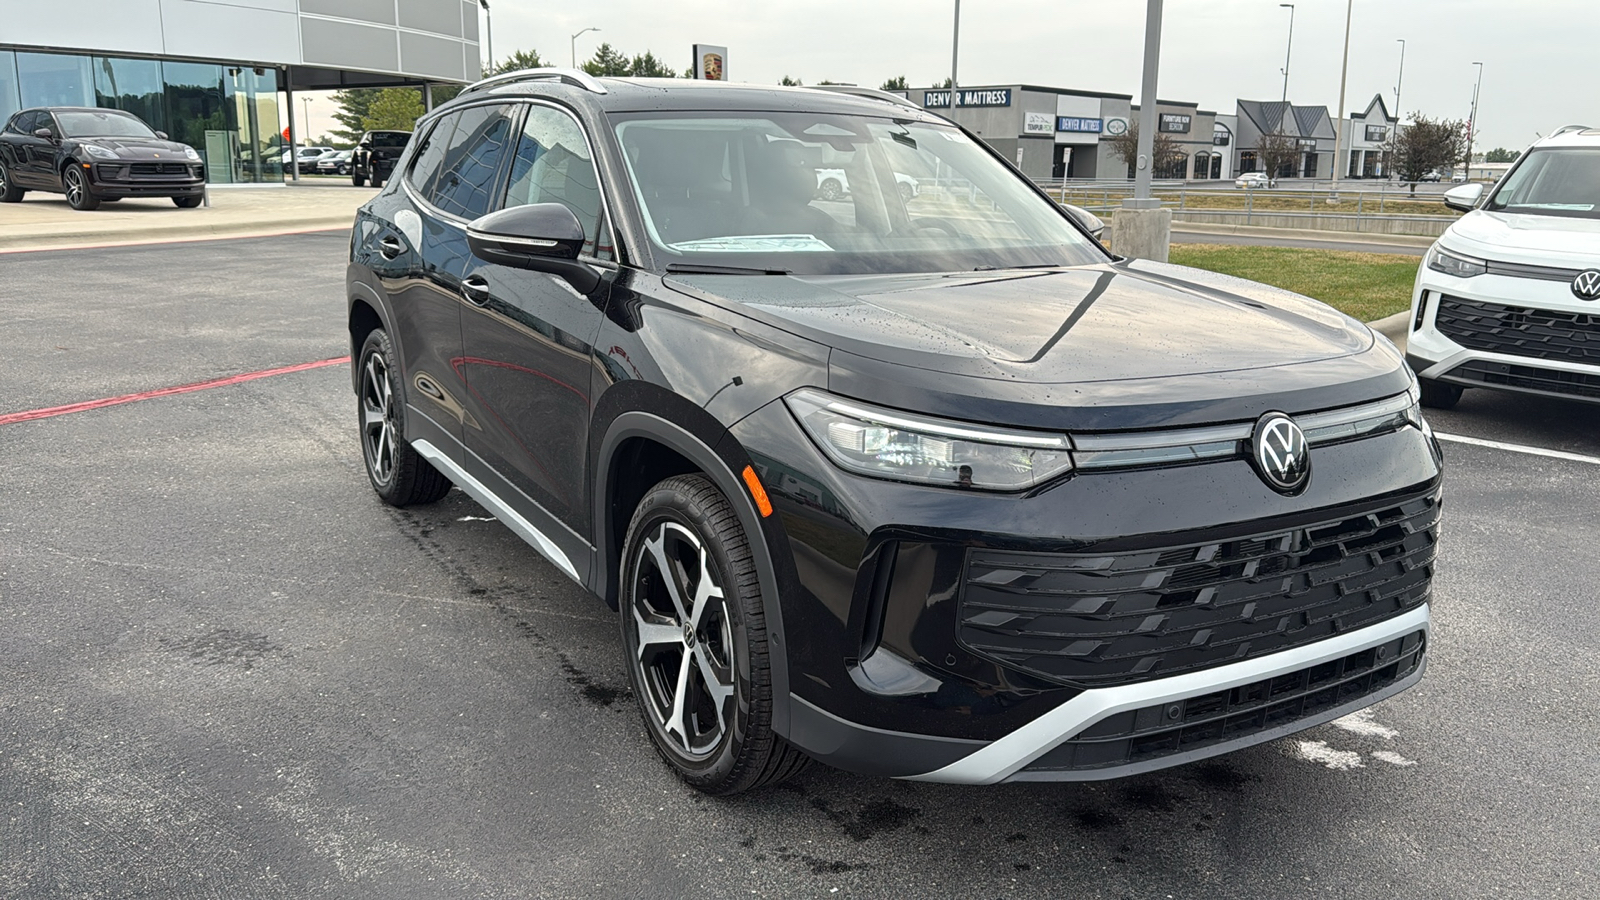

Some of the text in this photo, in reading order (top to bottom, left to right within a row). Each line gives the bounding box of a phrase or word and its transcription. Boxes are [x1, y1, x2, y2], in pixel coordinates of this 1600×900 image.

[926, 90, 1007, 106] DENVR MATTRESS
[1062, 118, 1080, 131] DENVER
[1080, 119, 1100, 131] MATTRESS
[1260, 418, 1309, 487] VW
